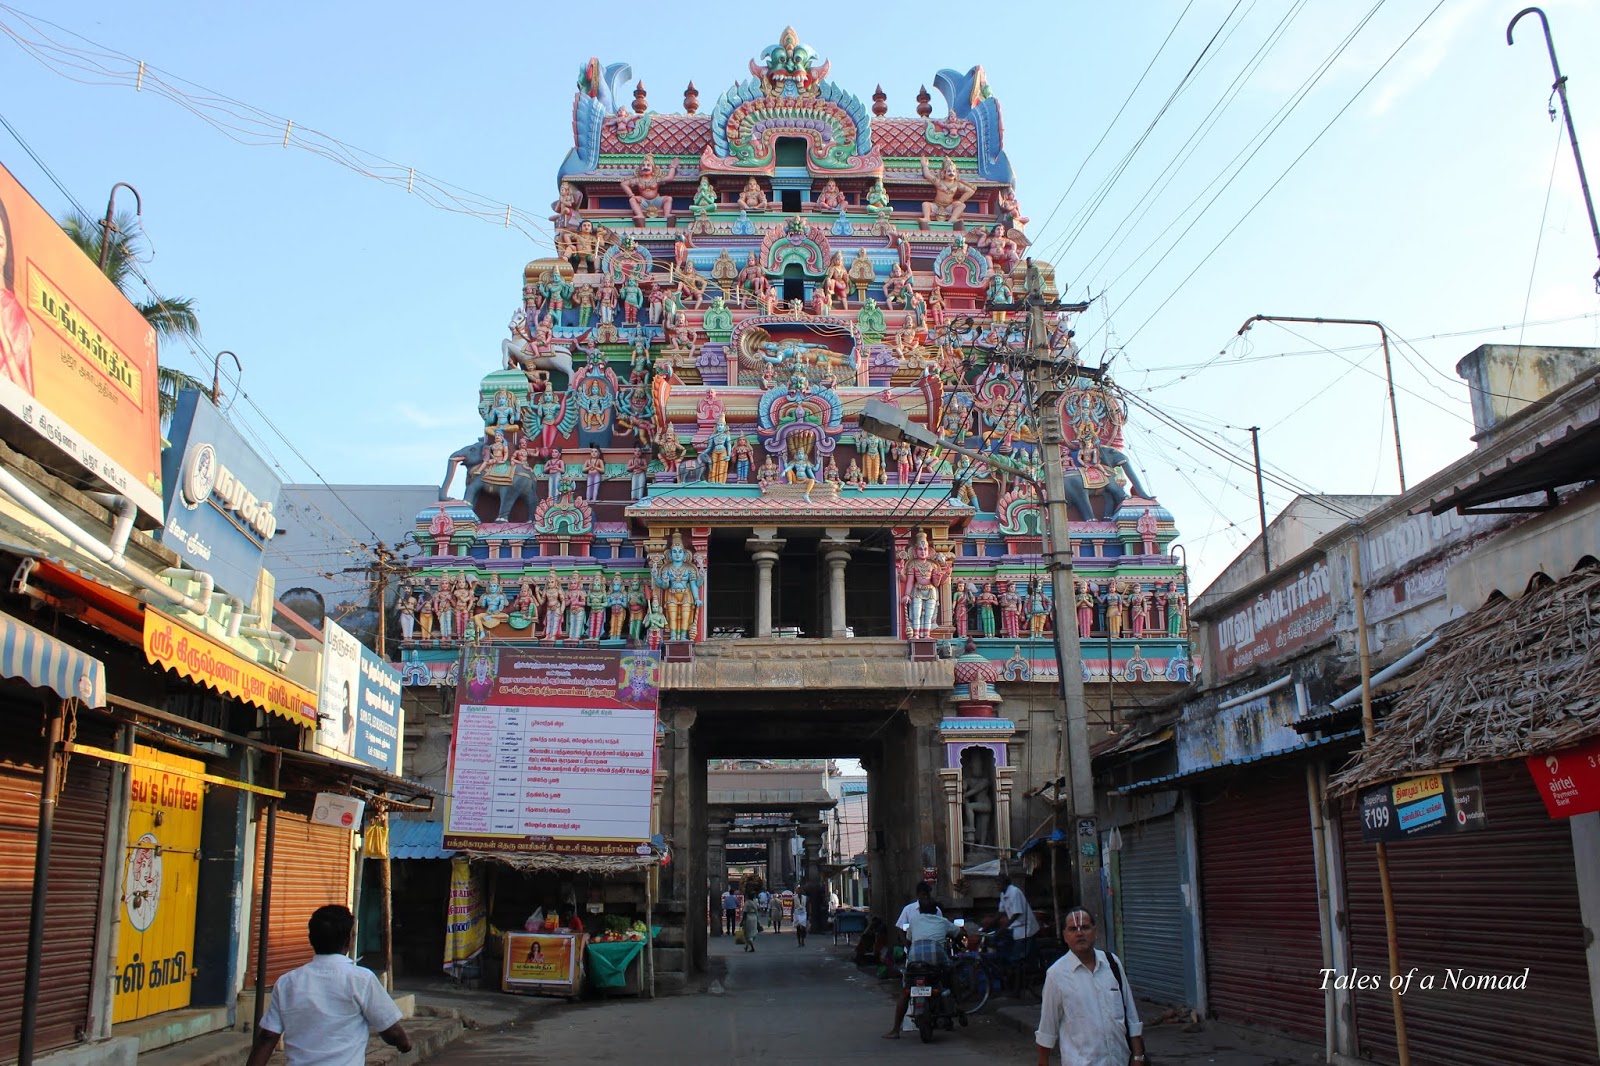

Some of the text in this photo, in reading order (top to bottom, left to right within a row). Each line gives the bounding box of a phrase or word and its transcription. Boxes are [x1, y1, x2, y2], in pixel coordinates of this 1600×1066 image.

[39, 414, 77, 453] கிருஷ்ணா
[82, 449, 98, 471] பூஜா
[150, 625, 174, 661] ஸ்ரீ
[176, 636, 240, 687] கிருஷ்ணா
[241, 672, 266, 699] பூஜா
[268, 680, 301, 714] ஸ்டோர்
[161, 773, 198, 811] Coffee
[1419, 782, 1429, 793] 1.4
[1429, 777, 1439, 790] GB
[1549, 776, 1575, 792] airtel
[1553, 789, 1578, 799] Payments
[1556, 798, 1570, 806] Bank
[1364, 806, 1389, 829] ₹199
[1466, 812, 1485, 820] vodafone
[149, 951, 187, 990] காபி
